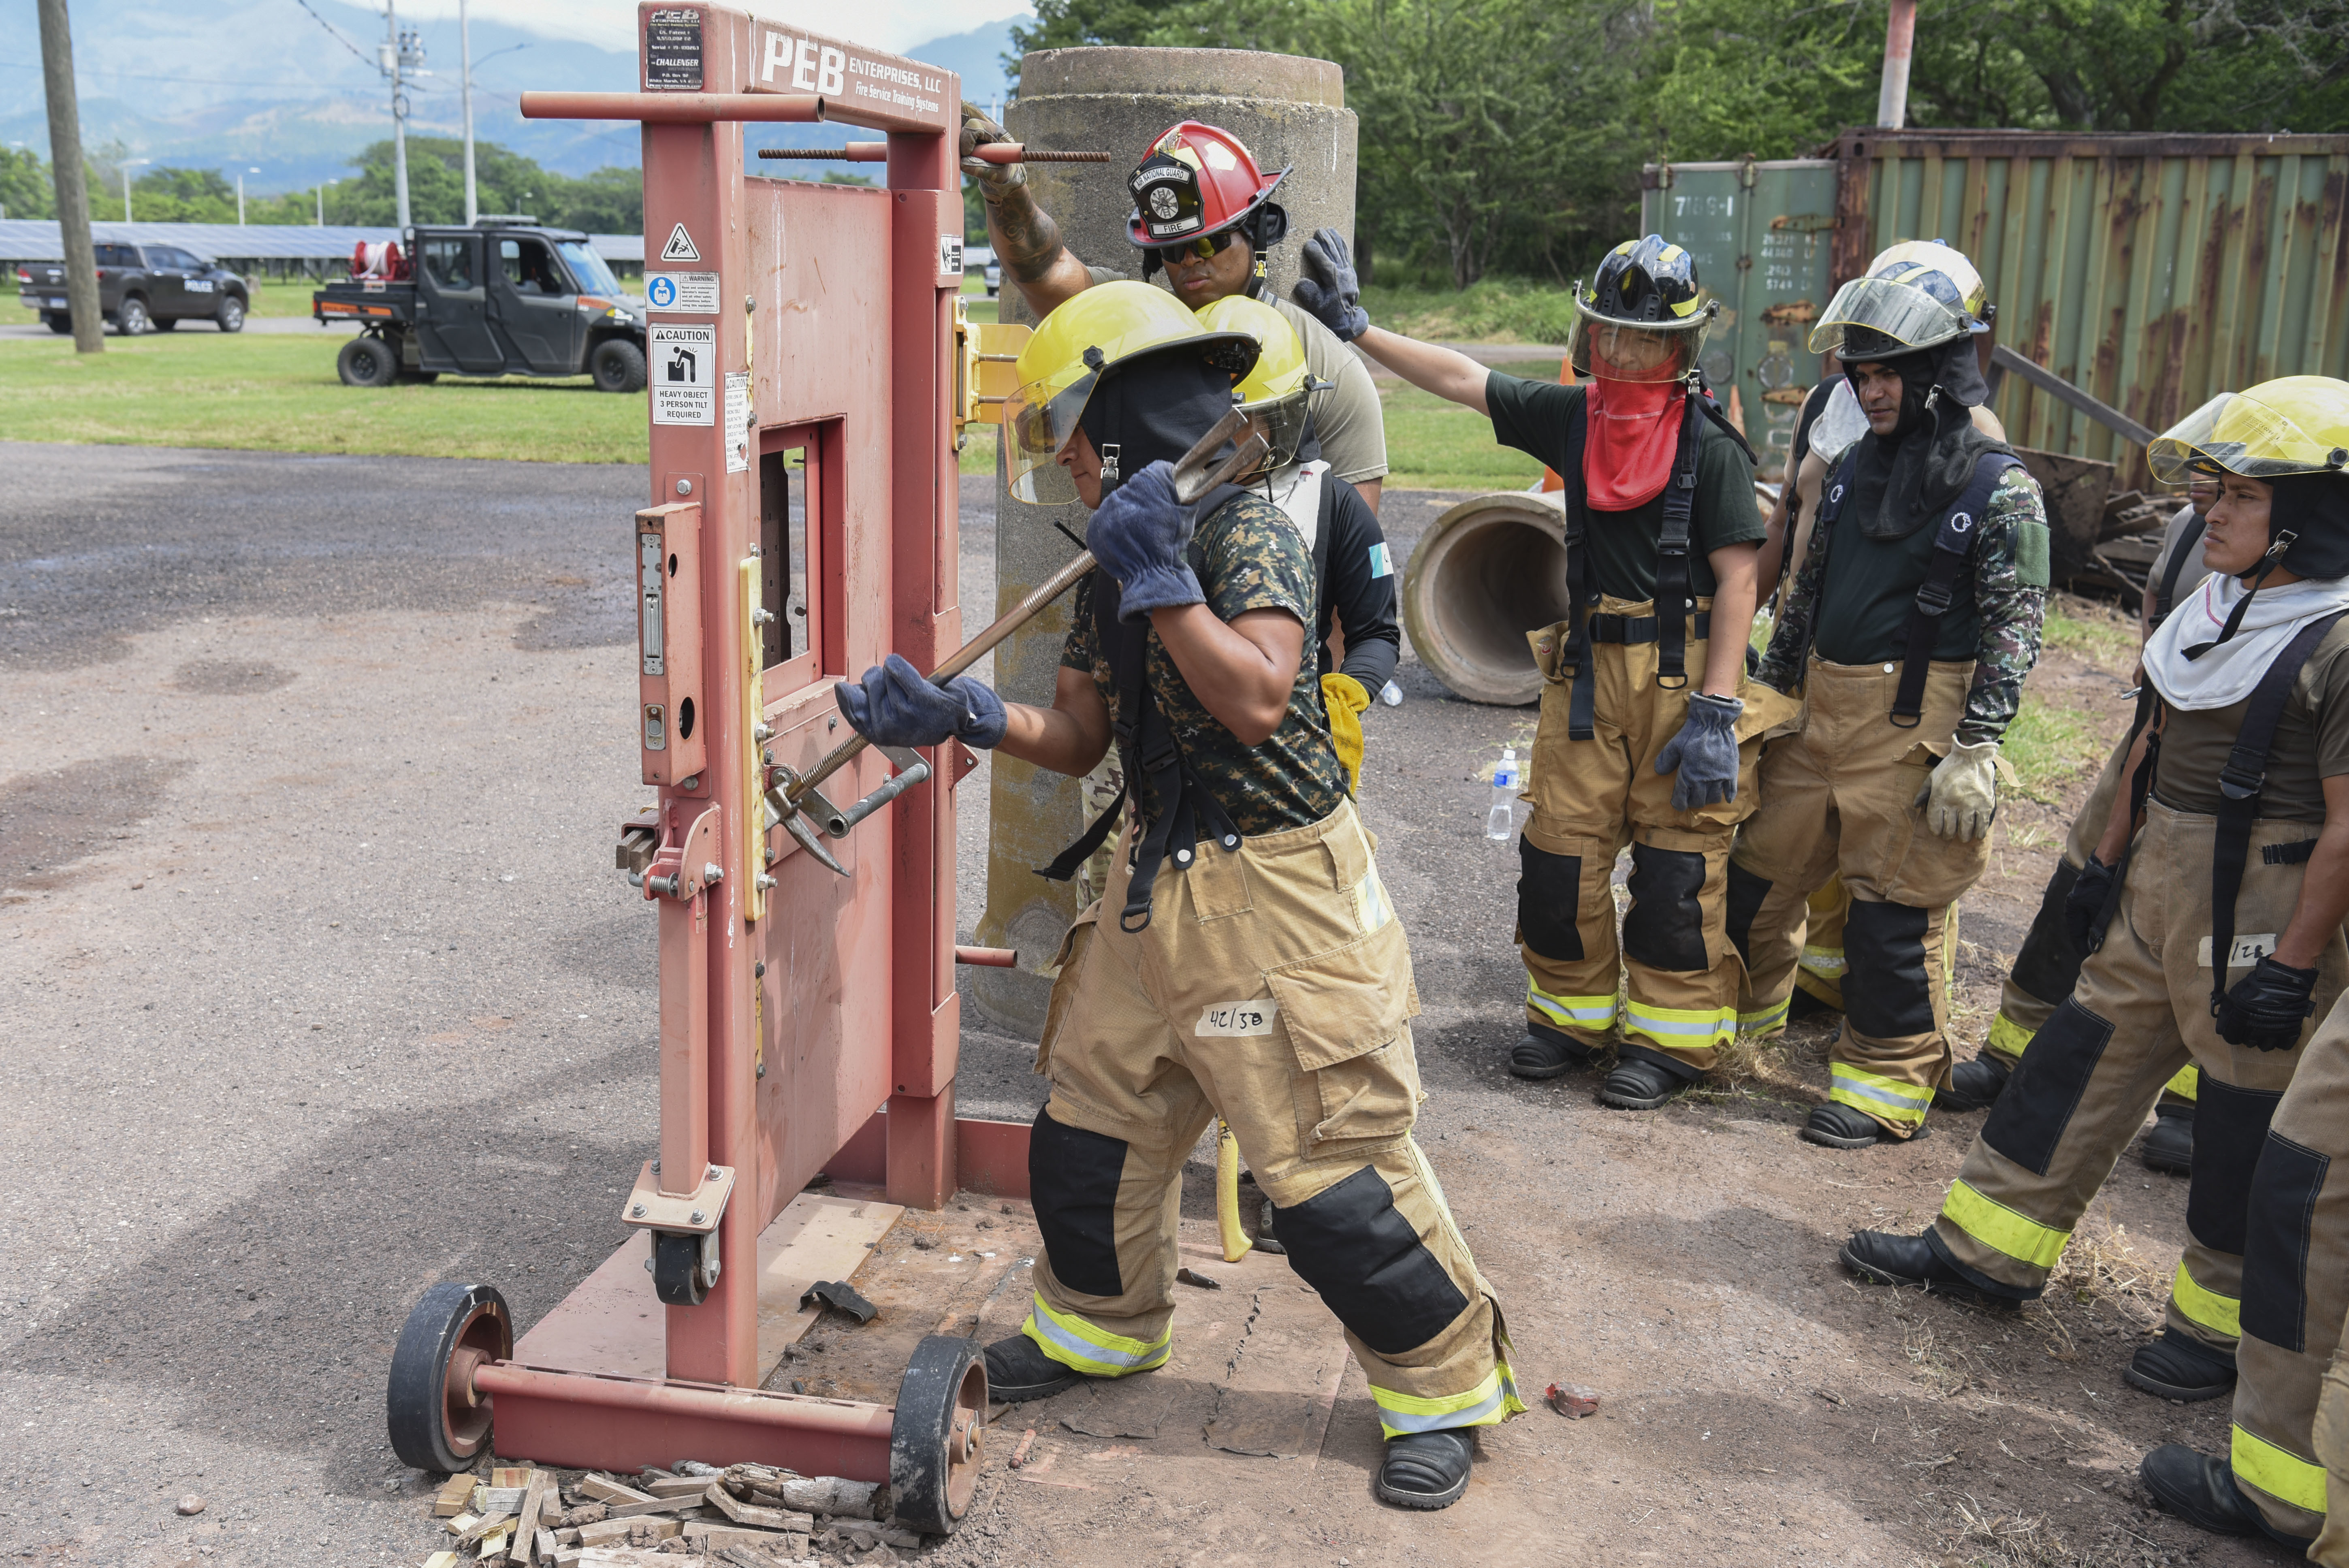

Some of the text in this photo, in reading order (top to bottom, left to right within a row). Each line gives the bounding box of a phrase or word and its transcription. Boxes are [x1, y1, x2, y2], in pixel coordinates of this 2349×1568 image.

[656, 58, 699, 66] CHALLENGER
[761, 30, 846, 97] PEB
[849, 56, 941, 94] ENTERPRISES, LLC
[855, 81, 939, 113] Fire Service Training Systems
[1135, 168, 1184, 188] AIR NATIONAL GUARD
[1163, 222, 1183, 233] FIRE
[184, 279, 213, 292] POLICE
[666, 330, 709, 341] CAUTION
[729, 378, 746, 389] CAUTION
[659, 390, 682, 398] HEAVY
[667, 410, 702, 419] REQUIRED
[2231, 941, 2264, 963] /28
